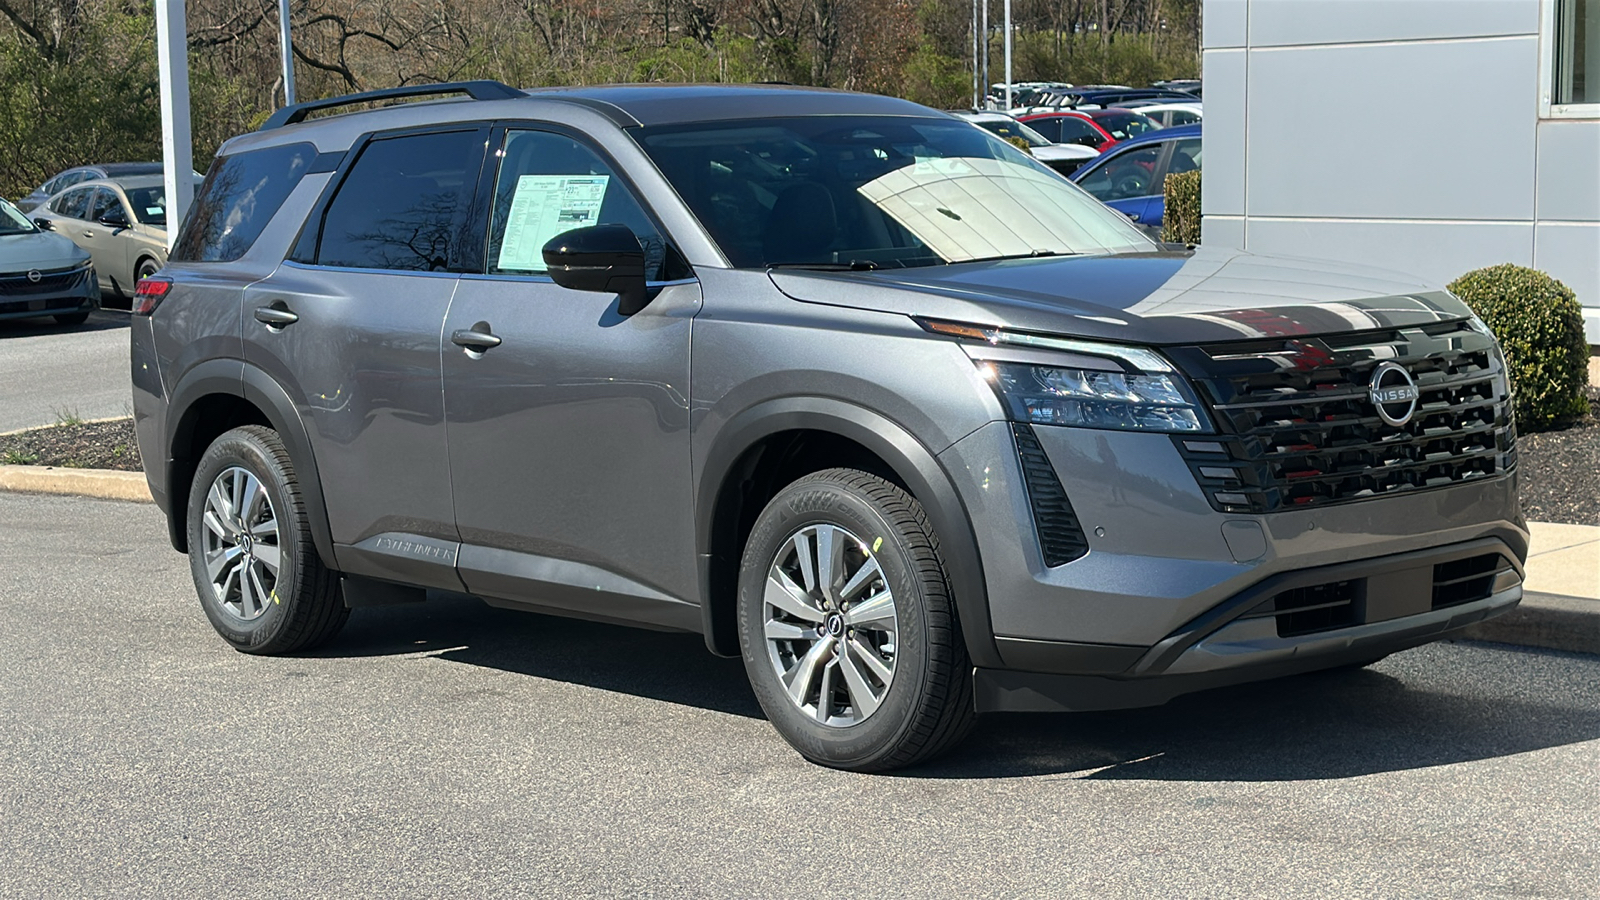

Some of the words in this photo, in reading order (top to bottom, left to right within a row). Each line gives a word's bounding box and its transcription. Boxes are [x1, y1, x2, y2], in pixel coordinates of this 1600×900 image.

[1372, 387, 1419, 402] NISSAN
[376, 537, 454, 560] PATHFINDER
[741, 586, 754, 663] KUMHO
